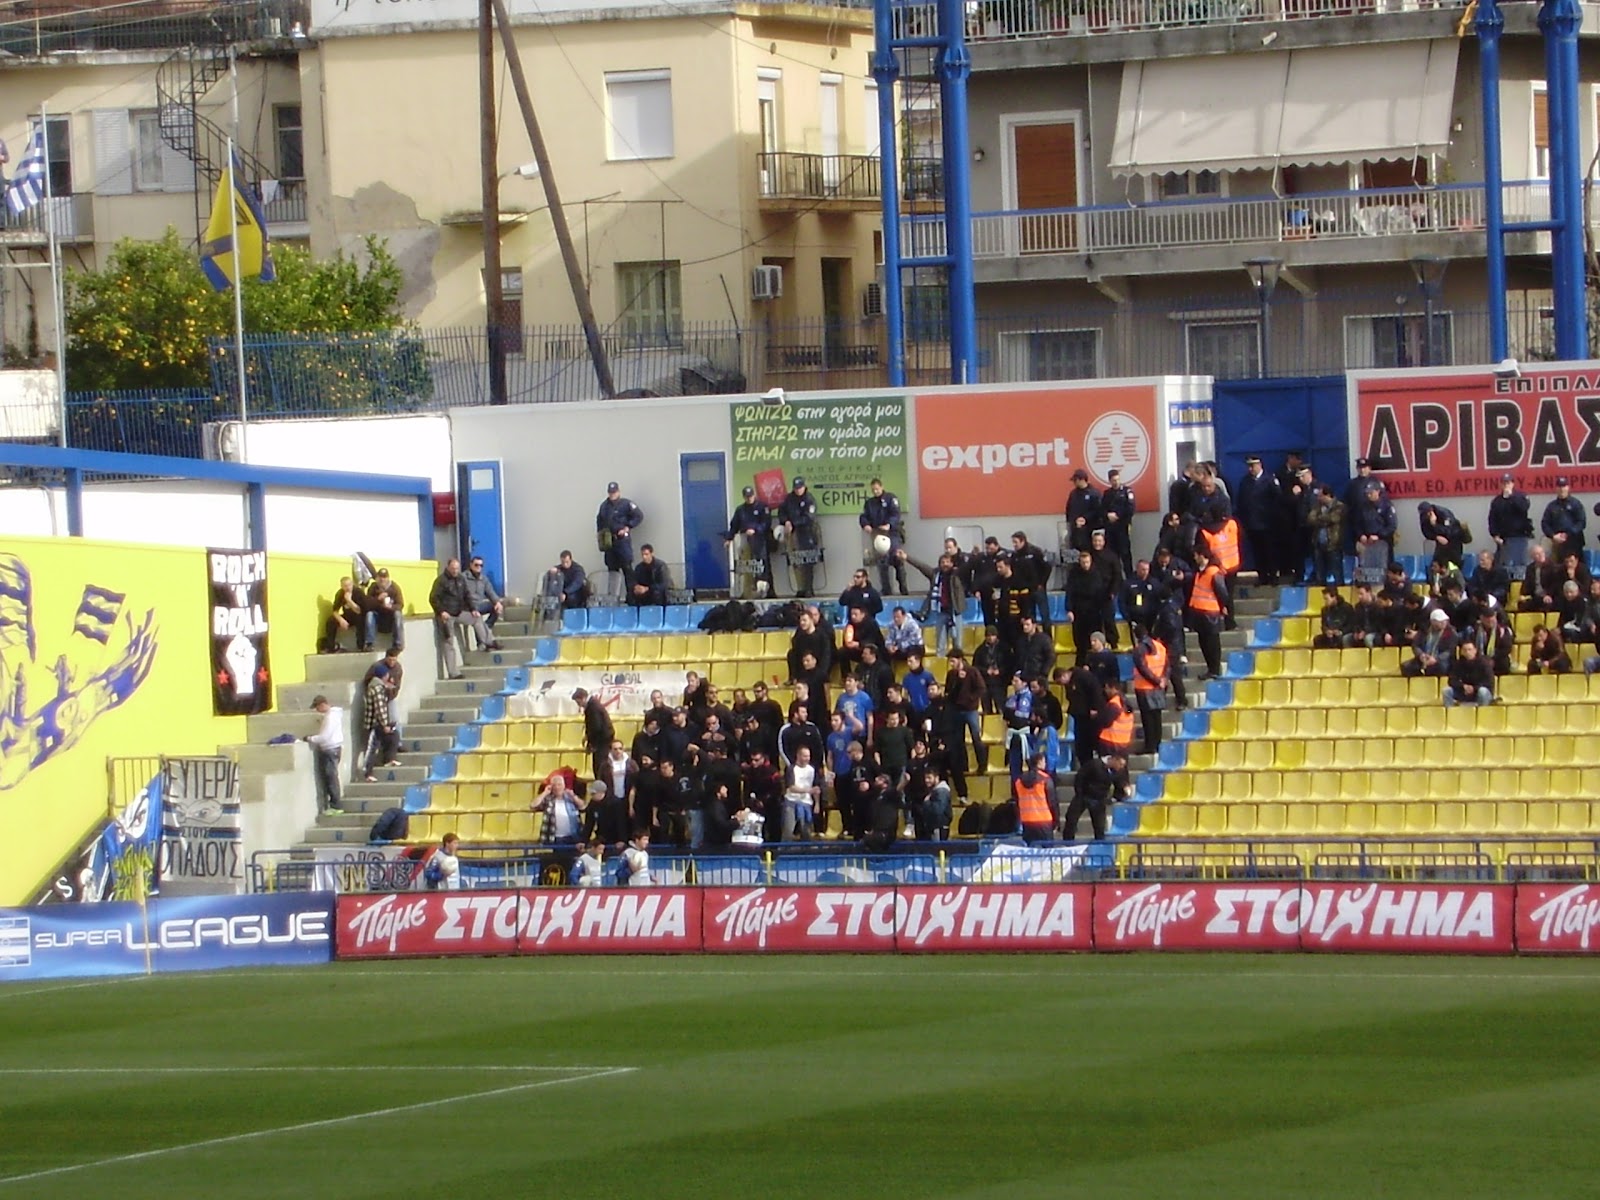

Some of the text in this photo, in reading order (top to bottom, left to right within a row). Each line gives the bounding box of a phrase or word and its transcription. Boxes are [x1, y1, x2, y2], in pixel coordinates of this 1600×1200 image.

[735, 402, 902, 423] ΨΩΝΙΖΩ στην αγορά μου
[736, 423, 901, 443] ΣΤΗΡΙΖΩ την ομάδα μου
[736, 443, 902, 462] ΕΙΜΑΙ στον τόπο μου
[922, 437, 1070, 474] expert
[822, 490, 867, 506] ΕΡΜΗ
[211, 551, 266, 584] ROCK
[214, 604, 268, 635] ROLL
[600, 673, 642, 685] GLOBAL
[157, 840, 243, 879] ΟΠΑΔΟΥΣ
[35, 911, 329, 950] SUPER LEAGUE
[348, 889, 687, 952] Πάμε ΣΤΟΙΧΗΜΑ
[715, 886, 1075, 947] Πάμε ΣΤΟΙΧΗΜΑ
[1107, 882, 1494, 945] Πάμε ΣΤΟΙΧΗΜΑ
[1530, 883, 1600, 947] Πάμ
